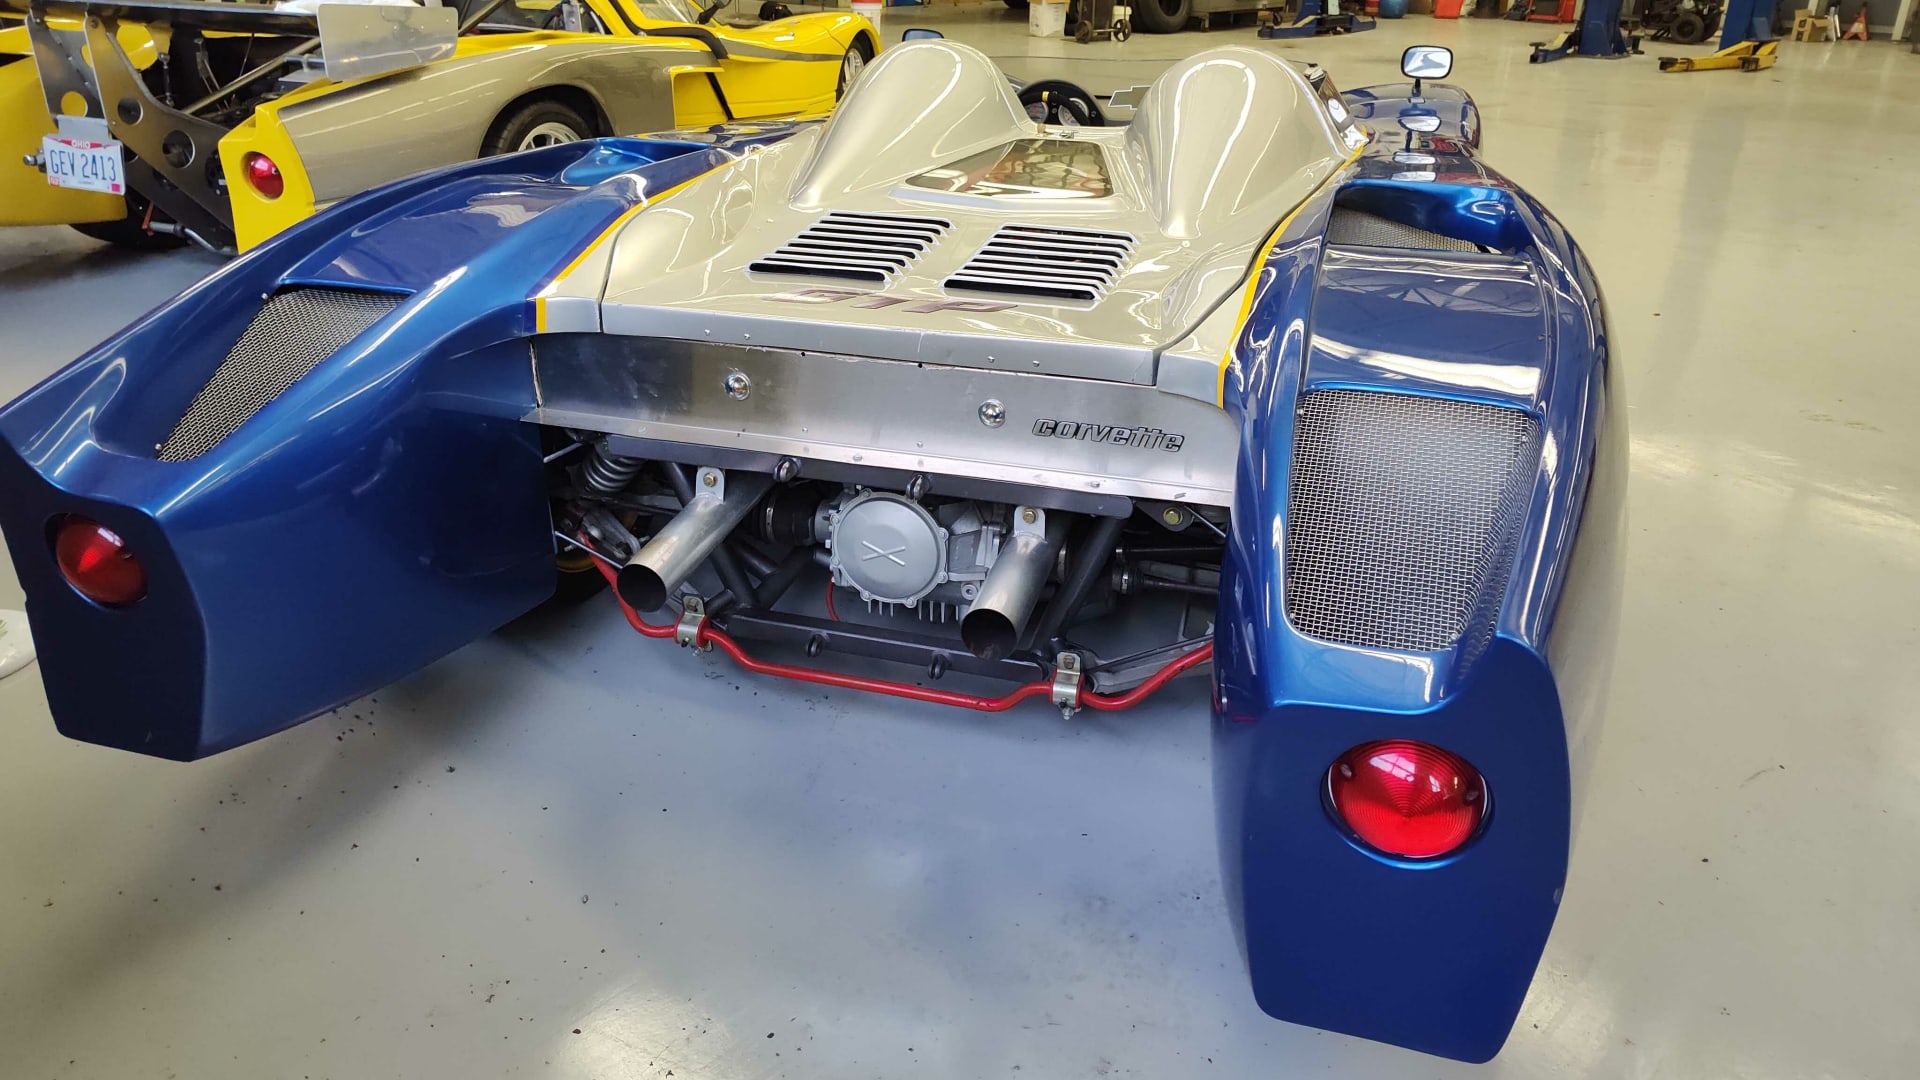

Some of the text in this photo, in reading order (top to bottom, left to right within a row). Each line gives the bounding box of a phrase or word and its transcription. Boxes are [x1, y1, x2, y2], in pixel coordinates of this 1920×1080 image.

[49, 149, 117, 181] GEV 2413
[1032, 418, 1185, 452] corvette
